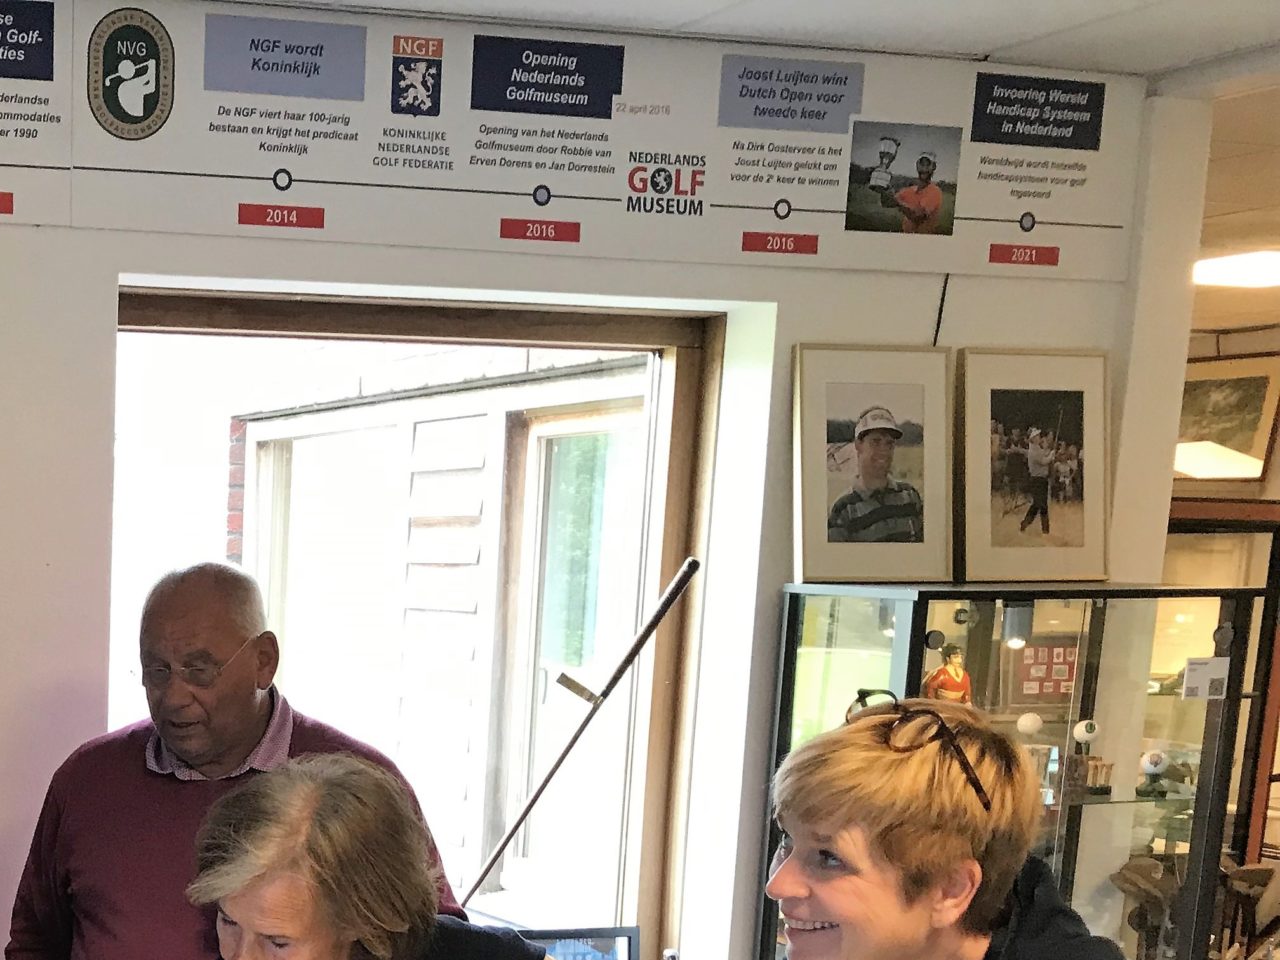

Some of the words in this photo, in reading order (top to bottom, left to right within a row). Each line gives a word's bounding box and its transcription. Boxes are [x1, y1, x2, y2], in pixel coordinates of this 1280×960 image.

[7, 29, 43, 45] Golf-
[117, 41, 147, 57] NVG
[249, 39, 281, 54] NGF
[284, 43, 324, 57] wordt
[399, 38, 439, 56] NGF
[251, 58, 321, 78] Koninklijk
[522, 50, 578, 70] Opening
[511, 68, 585, 87] Nederlands
[738, 67, 773, 81] Joost
[821, 72, 848, 86] wint
[506, 86, 589, 106] Golfmuseum
[739, 85, 776, 99] Dutch
[780, 87, 812, 102] Open
[816, 93, 845, 103] voor
[993, 85, 1046, 104] Invoering
[217, 105, 231, 117] De
[234, 107, 257, 118] NGF
[259, 109, 281, 120] viert
[284, 111, 306, 121] haar
[309, 112, 350, 127] 100-jarig
[629, 103, 647, 115] april
[753, 104, 797, 119] tweede
[800, 107, 828, 120] keer
[986, 101, 1040, 120] Handicap
[1042, 106, 1091, 121] Systeem
[14, 128, 38, 139] 1990
[209, 122, 249, 135] bestaan
[251, 126, 263, 136] en
[266, 125, 292, 140] krijgt
[294, 128, 310, 139] het
[312, 130, 359, 141] predicaat
[382, 128, 447, 142] KONINKLIJKE
[479, 123, 519, 138] Opening
[521, 128, 538, 138] van
[540, 128, 555, 139] het
[557, 129, 609, 142] Nederlands
[1001, 120, 1012, 133] in
[1015, 121, 1074, 137] Nederland
[259, 142, 309, 156] Koninklijk
[378, 142, 450, 156] NEDERLANDSE
[475, 139, 534, 153] Golfmuseum
[536, 144, 558, 155] door
[560, 145, 593, 157] Robbie
[595, 148, 612, 158] van
[828, 146, 842, 156] het
[372, 156, 399, 167] GOLF
[403, 159, 454, 171] FEDERATIE
[469, 156, 497, 167] Erven
[499, 157, 533, 169] Dorens
[535, 160, 547, 170] en
[548, 161, 565, 171] Jan
[567, 161, 616, 175] Dorrestein
[629, 151, 707, 167] NEDERLANDS
[628, 165, 706, 196] GOLF
[730, 173, 751, 182] voor
[776, 175, 796, 184] keer
[626, 195, 704, 216] MUSEUM
[266, 209, 297, 224] 2014
[526, 224, 555, 238] 2016
[766, 236, 794, 250] 2016
[1011, 248, 1037, 262] 2021
